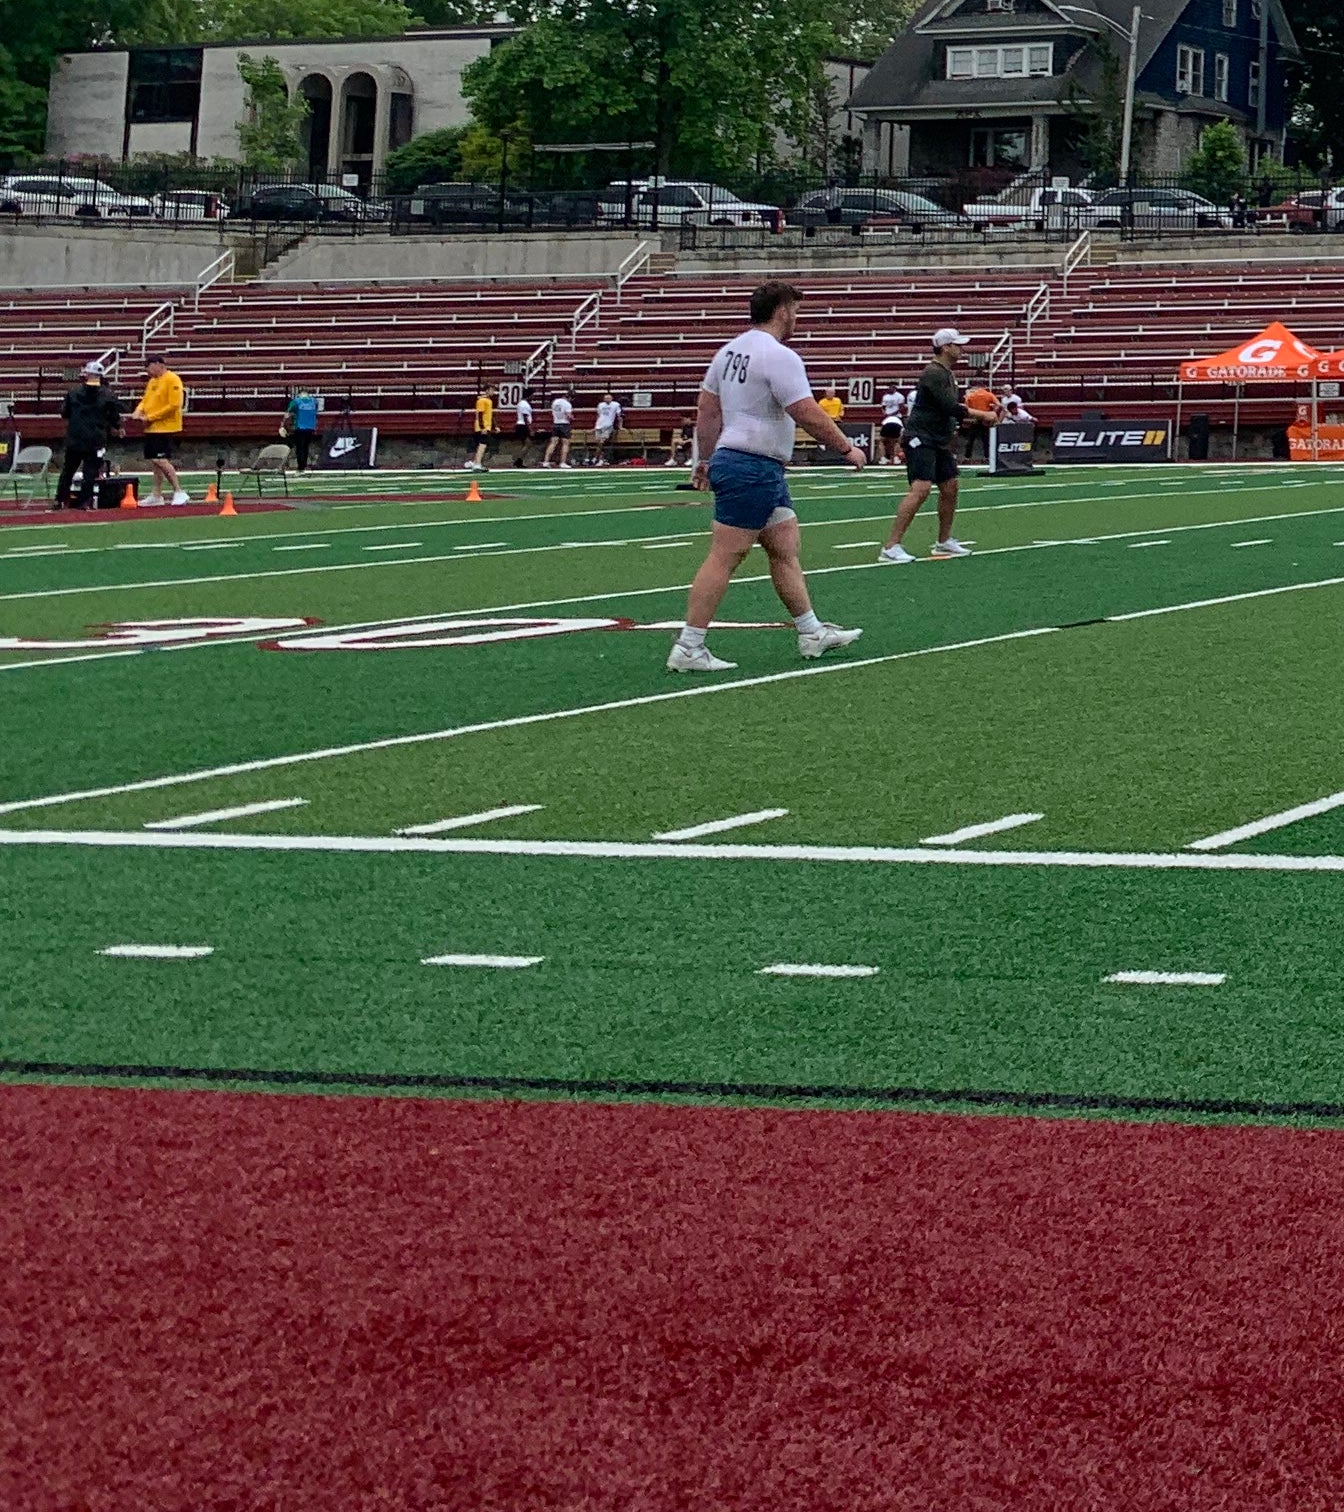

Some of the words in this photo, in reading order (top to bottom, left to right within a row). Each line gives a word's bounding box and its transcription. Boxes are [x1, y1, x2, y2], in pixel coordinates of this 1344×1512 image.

[1238, 338, 1284, 363] G
[722, 350, 750, 384] 798
[1206, 365, 1286, 378] GATORADE
[500, 385, 521, 405] 30
[851, 380, 871, 401] 40
